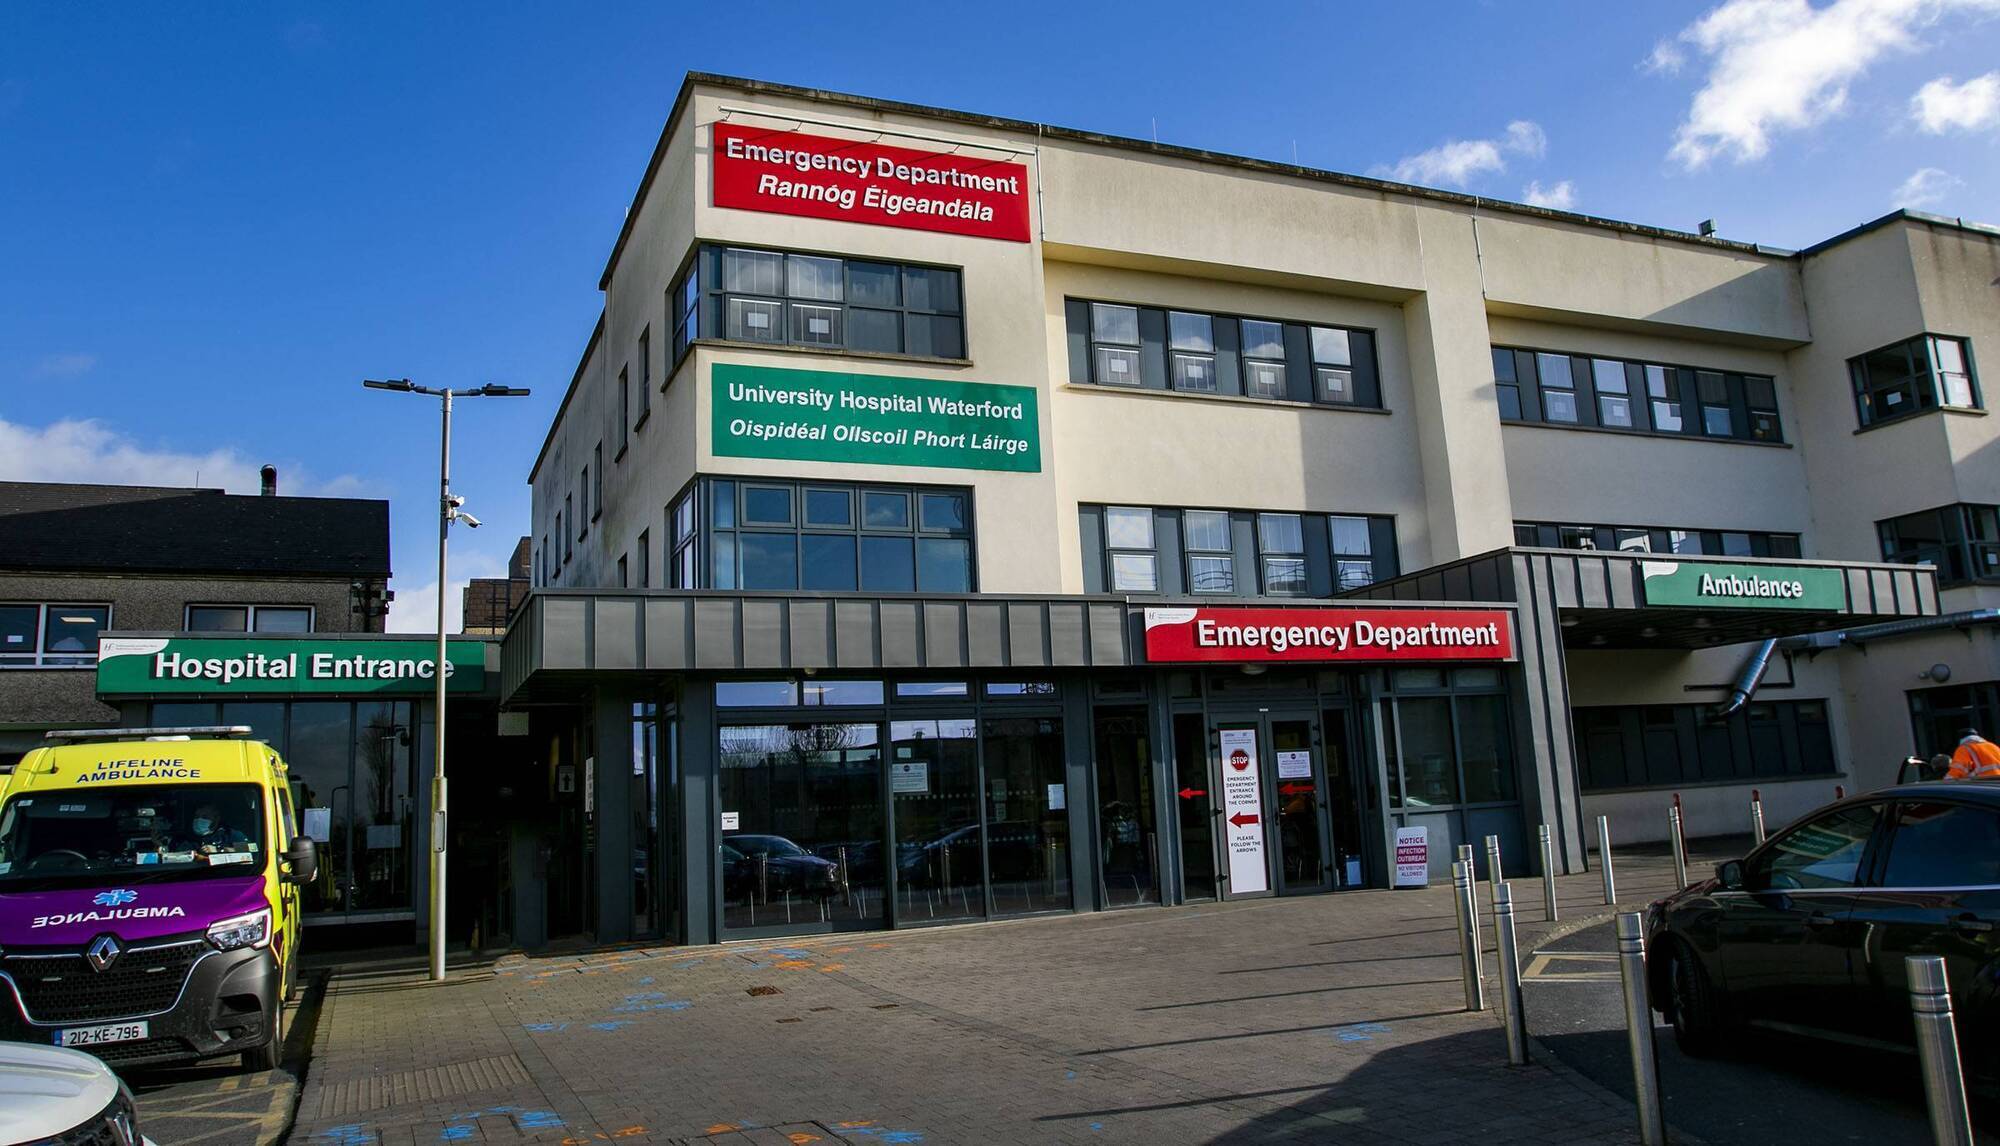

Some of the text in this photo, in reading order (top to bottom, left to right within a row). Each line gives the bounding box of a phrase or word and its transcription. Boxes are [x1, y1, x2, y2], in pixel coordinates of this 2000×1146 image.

[727, 137, 1019, 195] Emergency Department
[758, 174, 994, 221] Rannóg Éigeandála
[729, 383, 1023, 420] University Hospital Waterford
[730, 420, 1029, 453] Oispidéal Ollscoil Phort Láirge
[1702, 573, 1803, 598] Ambulance
[1198, 619, 1499, 652] Emergency Department
[155, 652, 298, 683] Hospital
[98, 759, 184, 770] LIFELINE
[1231, 756, 1248, 764] STOP
[76, 769, 201, 783] AMBULANCE
[69, 1026, 139, 1044] 212-KE-796
